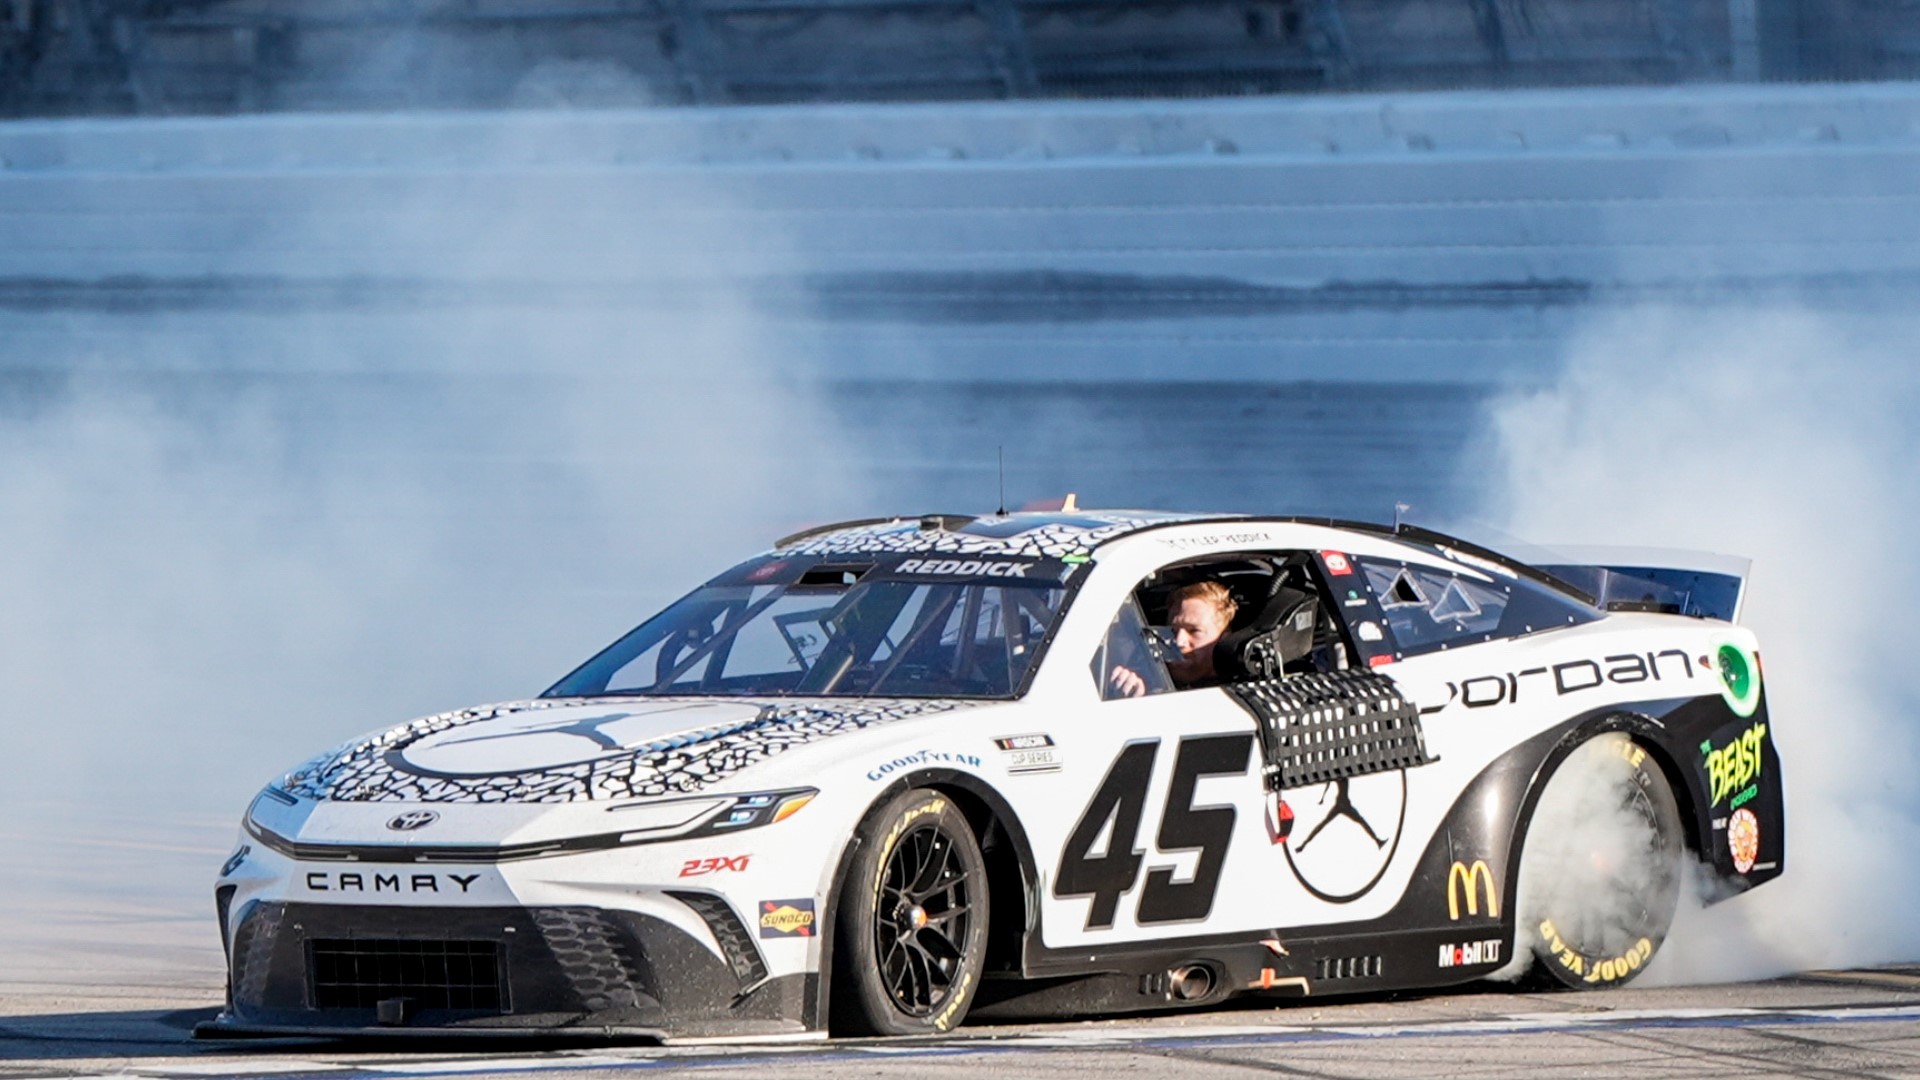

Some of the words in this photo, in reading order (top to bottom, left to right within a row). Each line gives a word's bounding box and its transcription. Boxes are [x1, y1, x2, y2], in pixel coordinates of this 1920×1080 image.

[894, 559, 1034, 578] REDDICK
[866, 749, 983, 782] GOODYEAR
[1703, 721, 1767, 809] BEAST
[1053, 729, 1256, 932] 45
[306, 872, 481, 893] CAMRY
[763, 915, 812, 926] SUNOCO
[1439, 941, 1482, 968] Mobil
[1540, 919, 1652, 984] GOODYEAR
